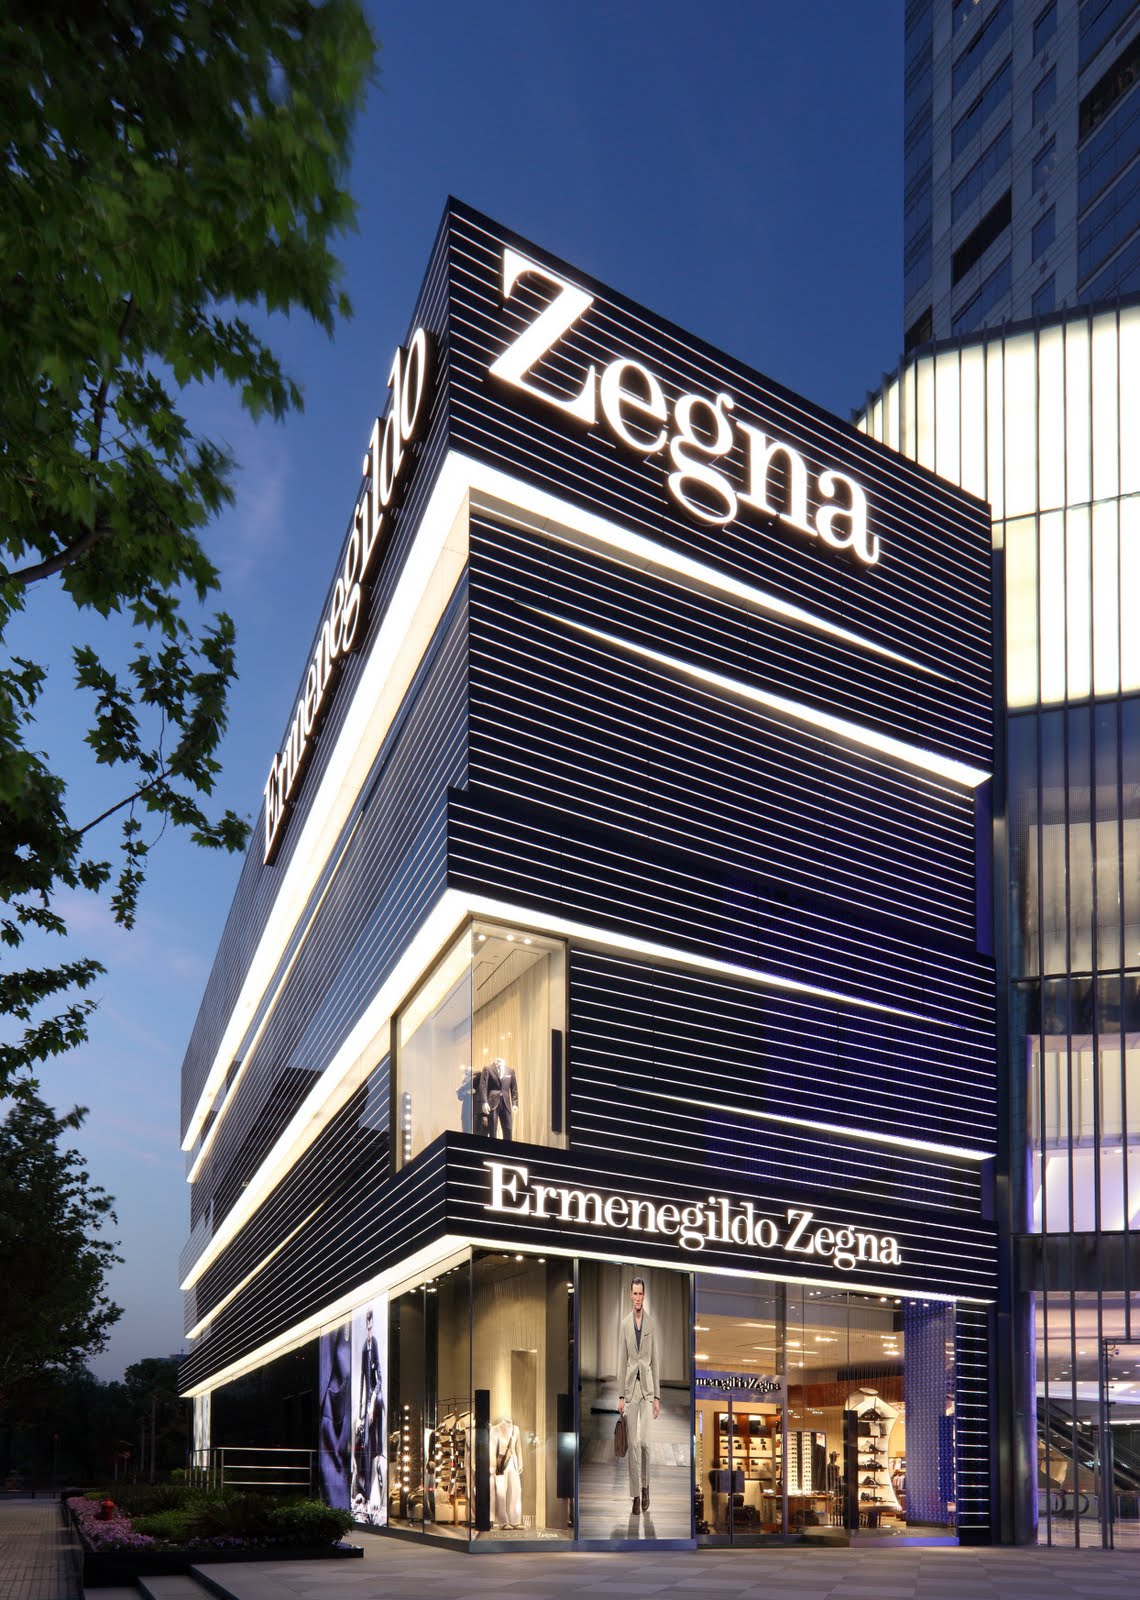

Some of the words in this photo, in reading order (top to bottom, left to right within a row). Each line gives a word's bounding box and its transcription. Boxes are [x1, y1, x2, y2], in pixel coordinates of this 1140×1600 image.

[488, 248, 880, 565] Zegna
[263, 327, 428, 865] Ermenegildo
[483, 1161, 778, 1251] Ermenegildo
[783, 1208, 902, 1271] Zegna
[695, 1376, 748, 1391] menegildo
